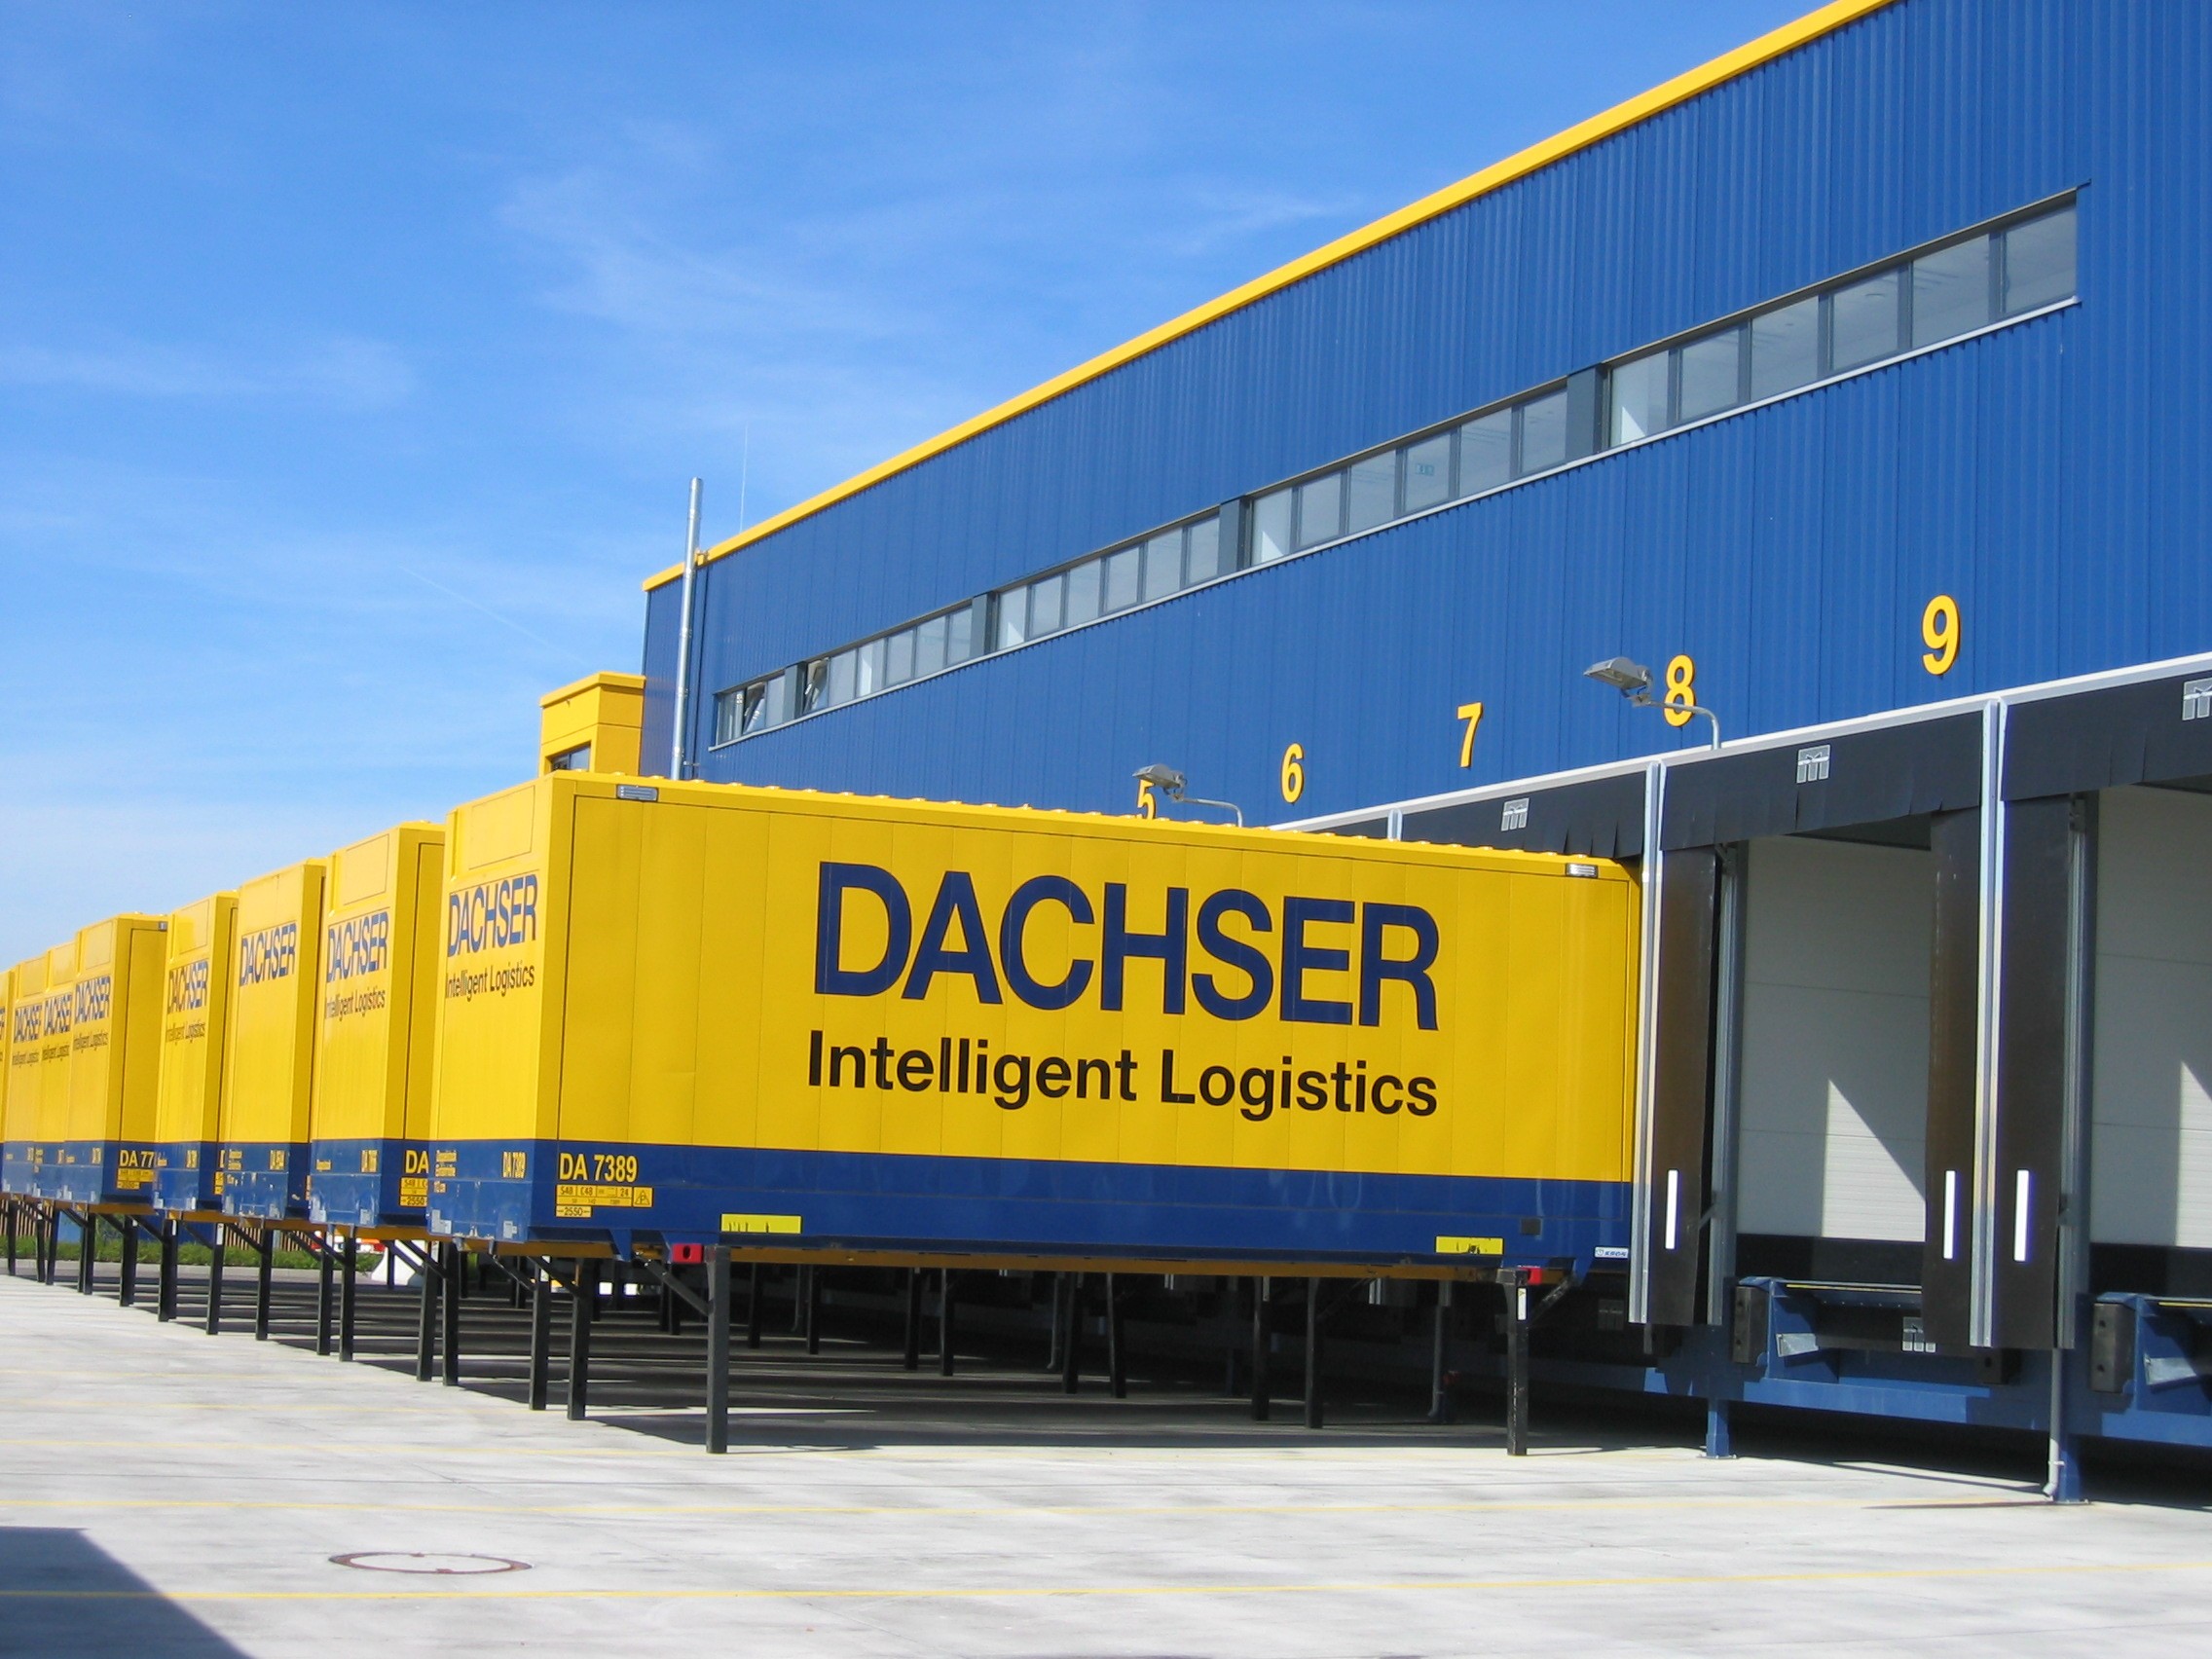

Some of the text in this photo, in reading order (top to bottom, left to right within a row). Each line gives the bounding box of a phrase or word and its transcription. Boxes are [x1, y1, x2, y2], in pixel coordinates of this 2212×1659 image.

[1921, 594, 1960, 676] 9
[1664, 653, 1695, 727] 8
[1456, 701, 1483, 768] 7
[1137, 779, 1156, 819] 5
[1280, 743, 1305, 803] 6
[326, 911, 388, 983] DACHSER
[447, 873, 537, 958] DACHSER
[814, 861, 1440, 1031] DACHSER
[239, 922, 297, 987] DACHSER
[445, 960, 535, 1002] Intelligent Logistics
[354, 986, 386, 1017] Logistics
[808, 1029, 1437, 1121] Intelligent Logistics
[120, 1150, 137, 1166] DA
[405, 1150, 429, 1174] DA
[559, 1152, 638, 1183] DA 7389
